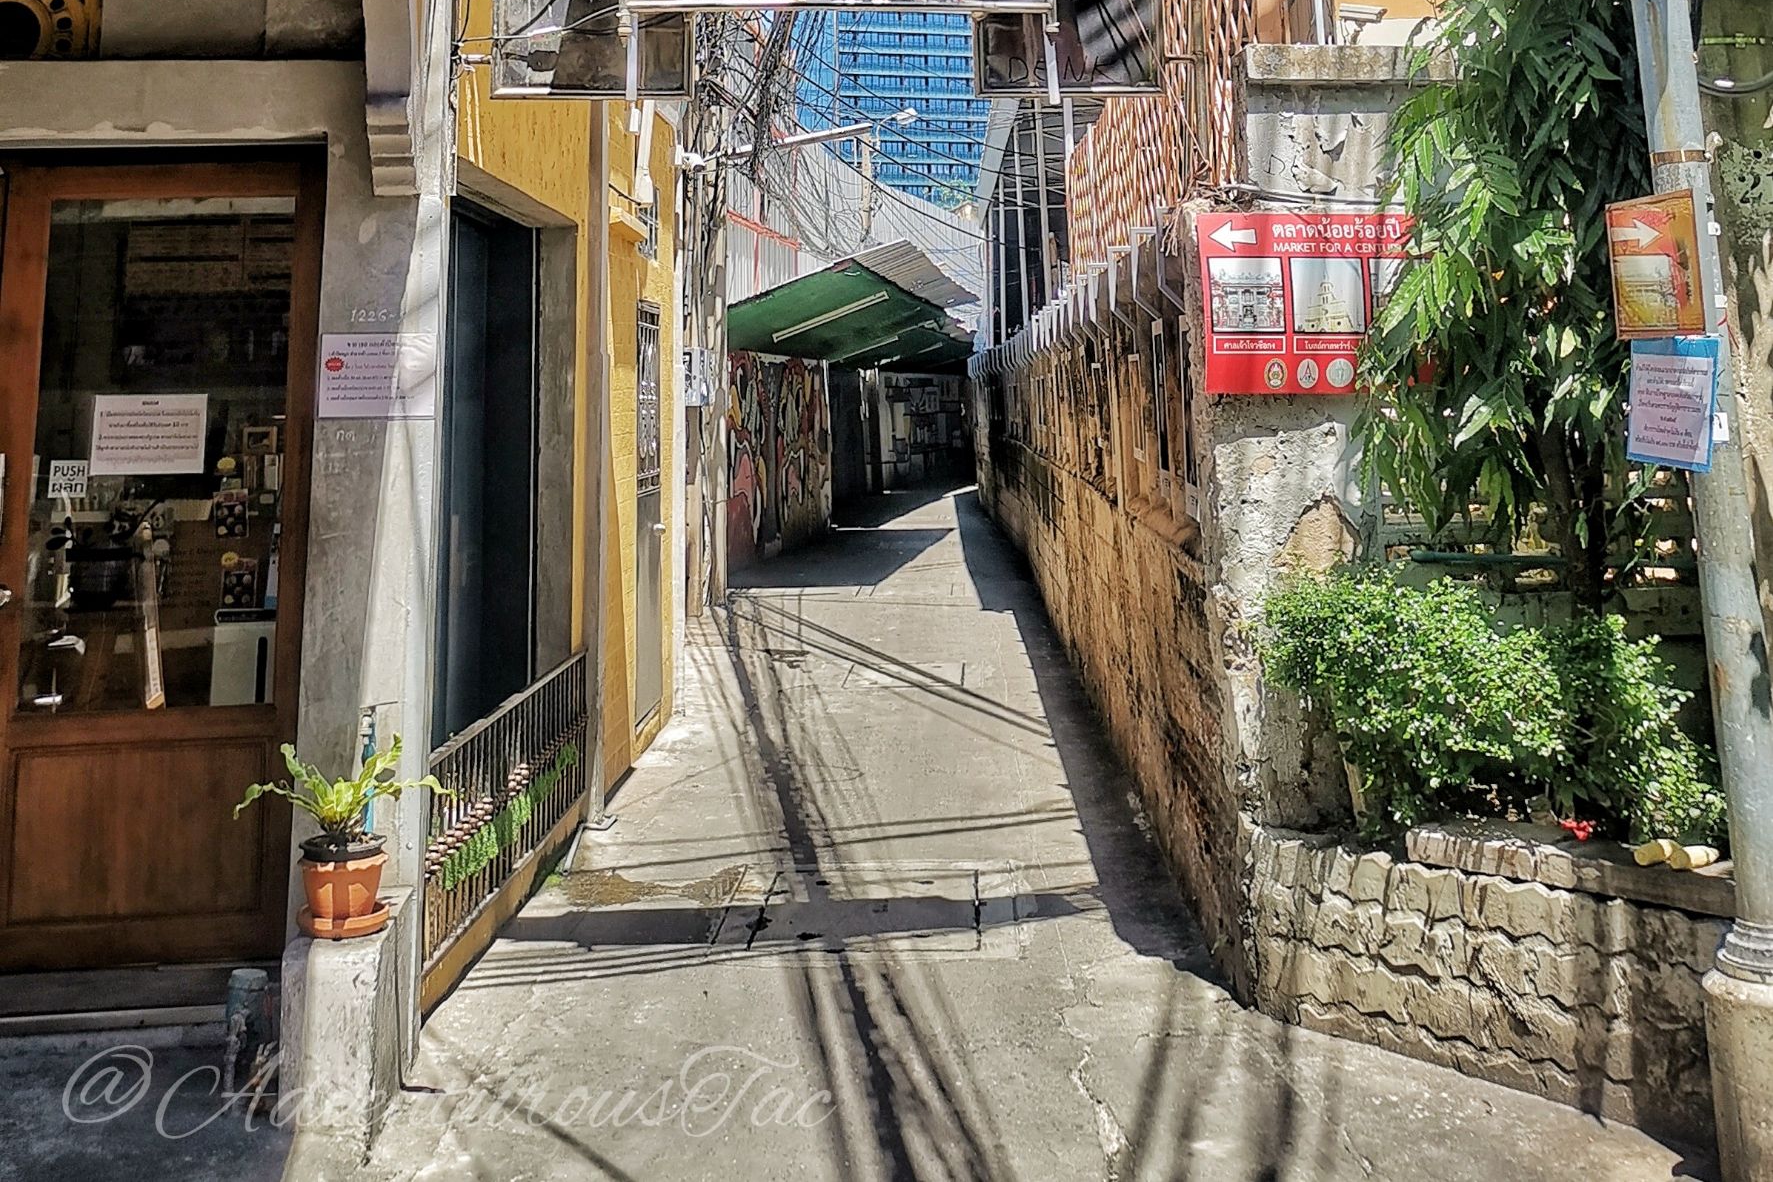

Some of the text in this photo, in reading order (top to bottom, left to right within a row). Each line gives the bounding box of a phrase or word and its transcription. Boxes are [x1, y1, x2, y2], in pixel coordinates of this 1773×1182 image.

[1272, 216, 1401, 239] ตลาดน้อยร้อยปี
[1273, 242, 1316, 252] MARKET
[1320, 242, 1341, 252] FOR
[1344, 242, 1353, 252] A
[54, 465, 86, 477] PUSH
[51, 477, 84, 493] ผลัก
